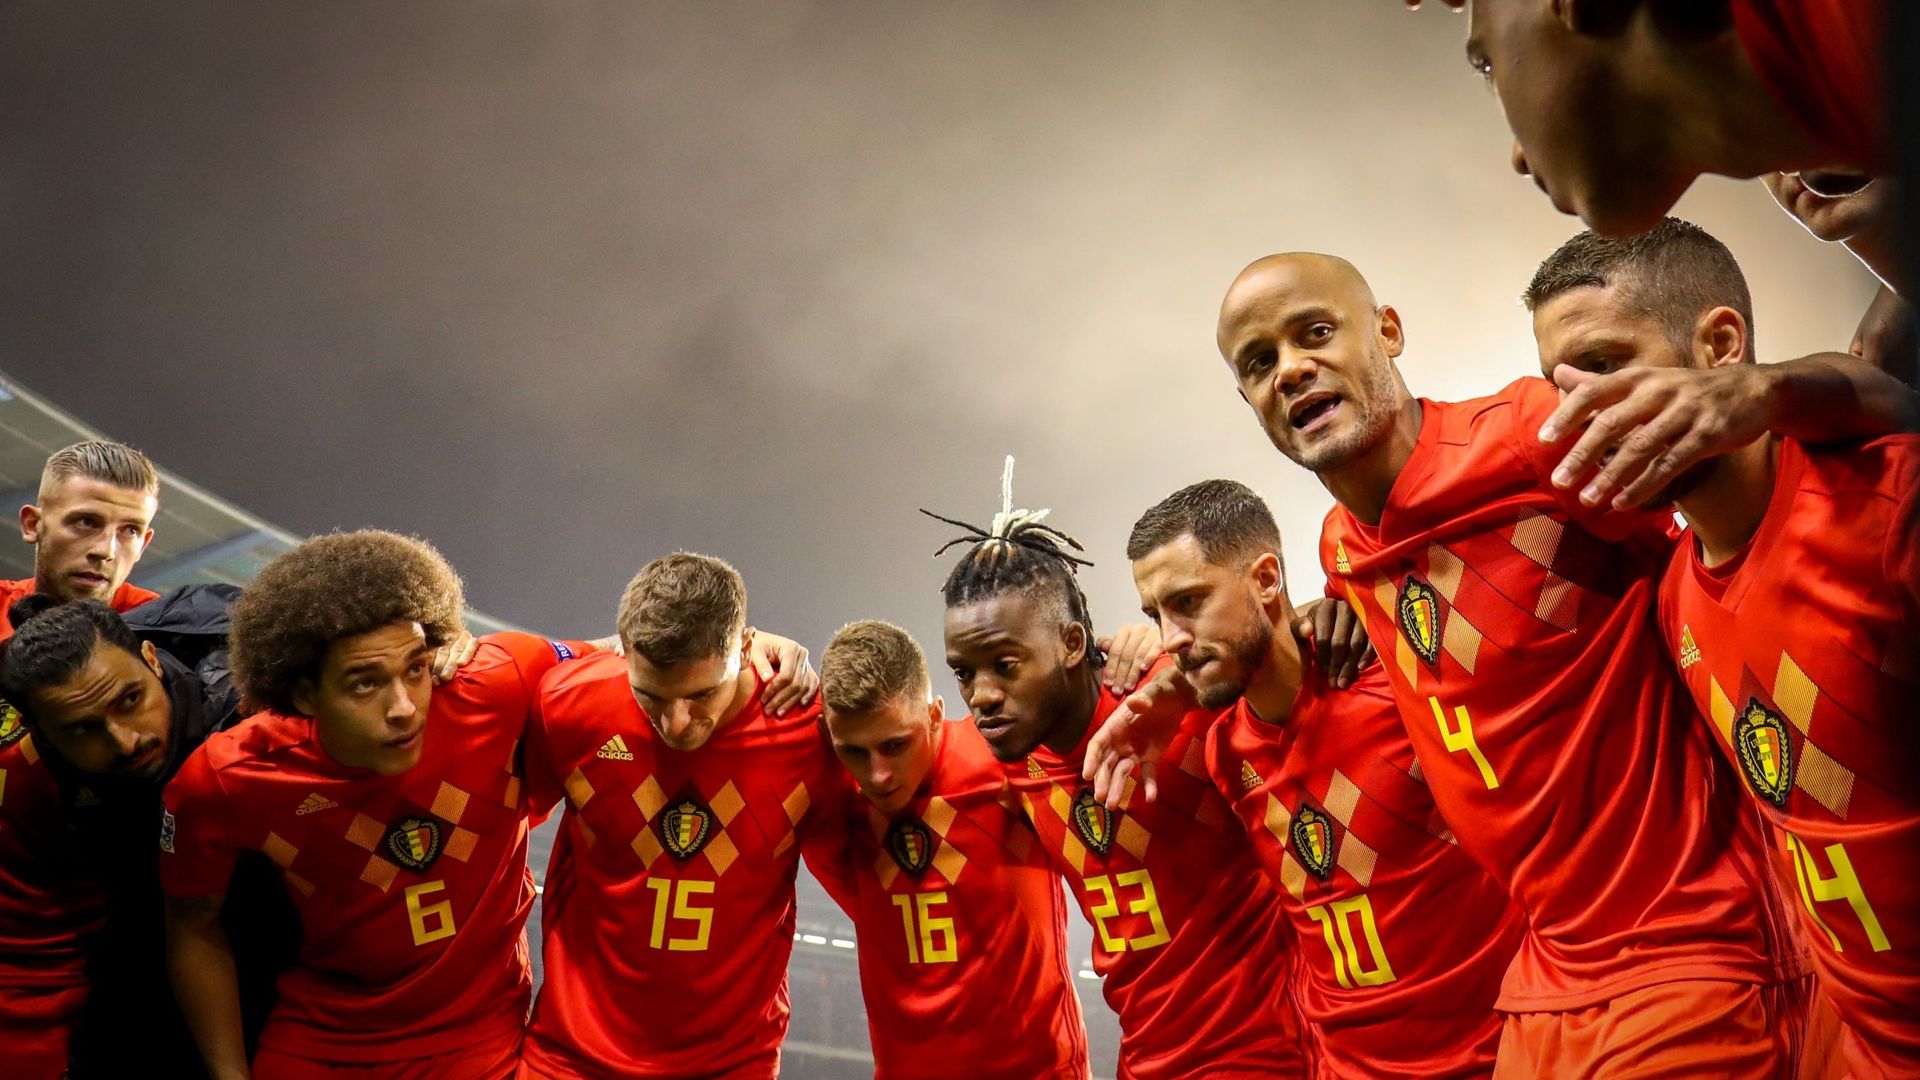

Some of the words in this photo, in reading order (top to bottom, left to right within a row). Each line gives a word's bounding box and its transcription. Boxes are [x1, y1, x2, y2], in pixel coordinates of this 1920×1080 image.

[596, 750, 634, 761] adidas
[1428, 696, 1499, 790] 4
[295, 801, 338, 815] adidas
[405, 880, 456, 946] 6
[647, 876, 715, 951] 15
[892, 892, 958, 963] 16
[1083, 869, 1171, 952] 23
[1787, 832, 1892, 952] 14
[1306, 894, 1396, 989] 10
